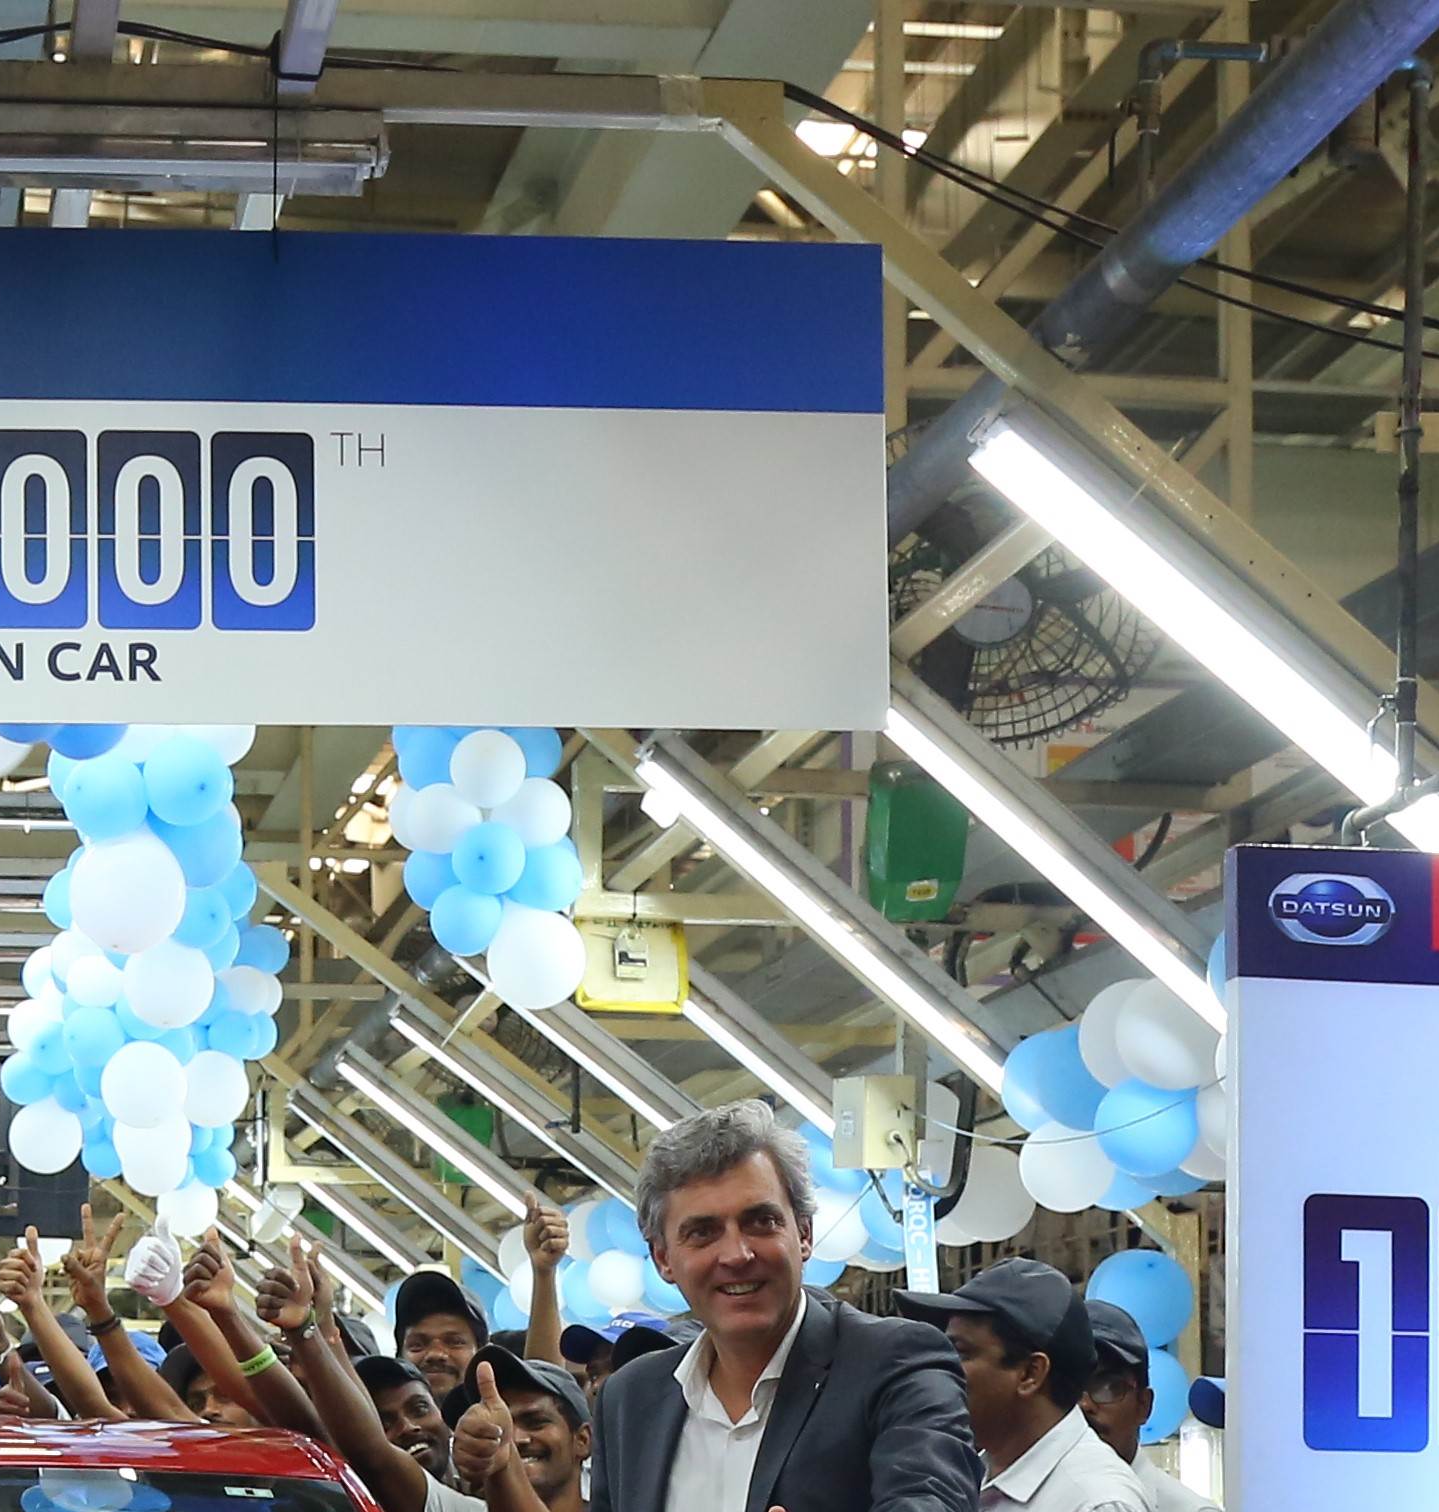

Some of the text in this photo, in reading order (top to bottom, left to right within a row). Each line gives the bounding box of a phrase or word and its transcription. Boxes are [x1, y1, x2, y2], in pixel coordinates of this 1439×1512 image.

[331, 432, 386, 467] TH
[47, 641, 162, 682] CAR
[1282, 899, 1382, 918] DATSUN
